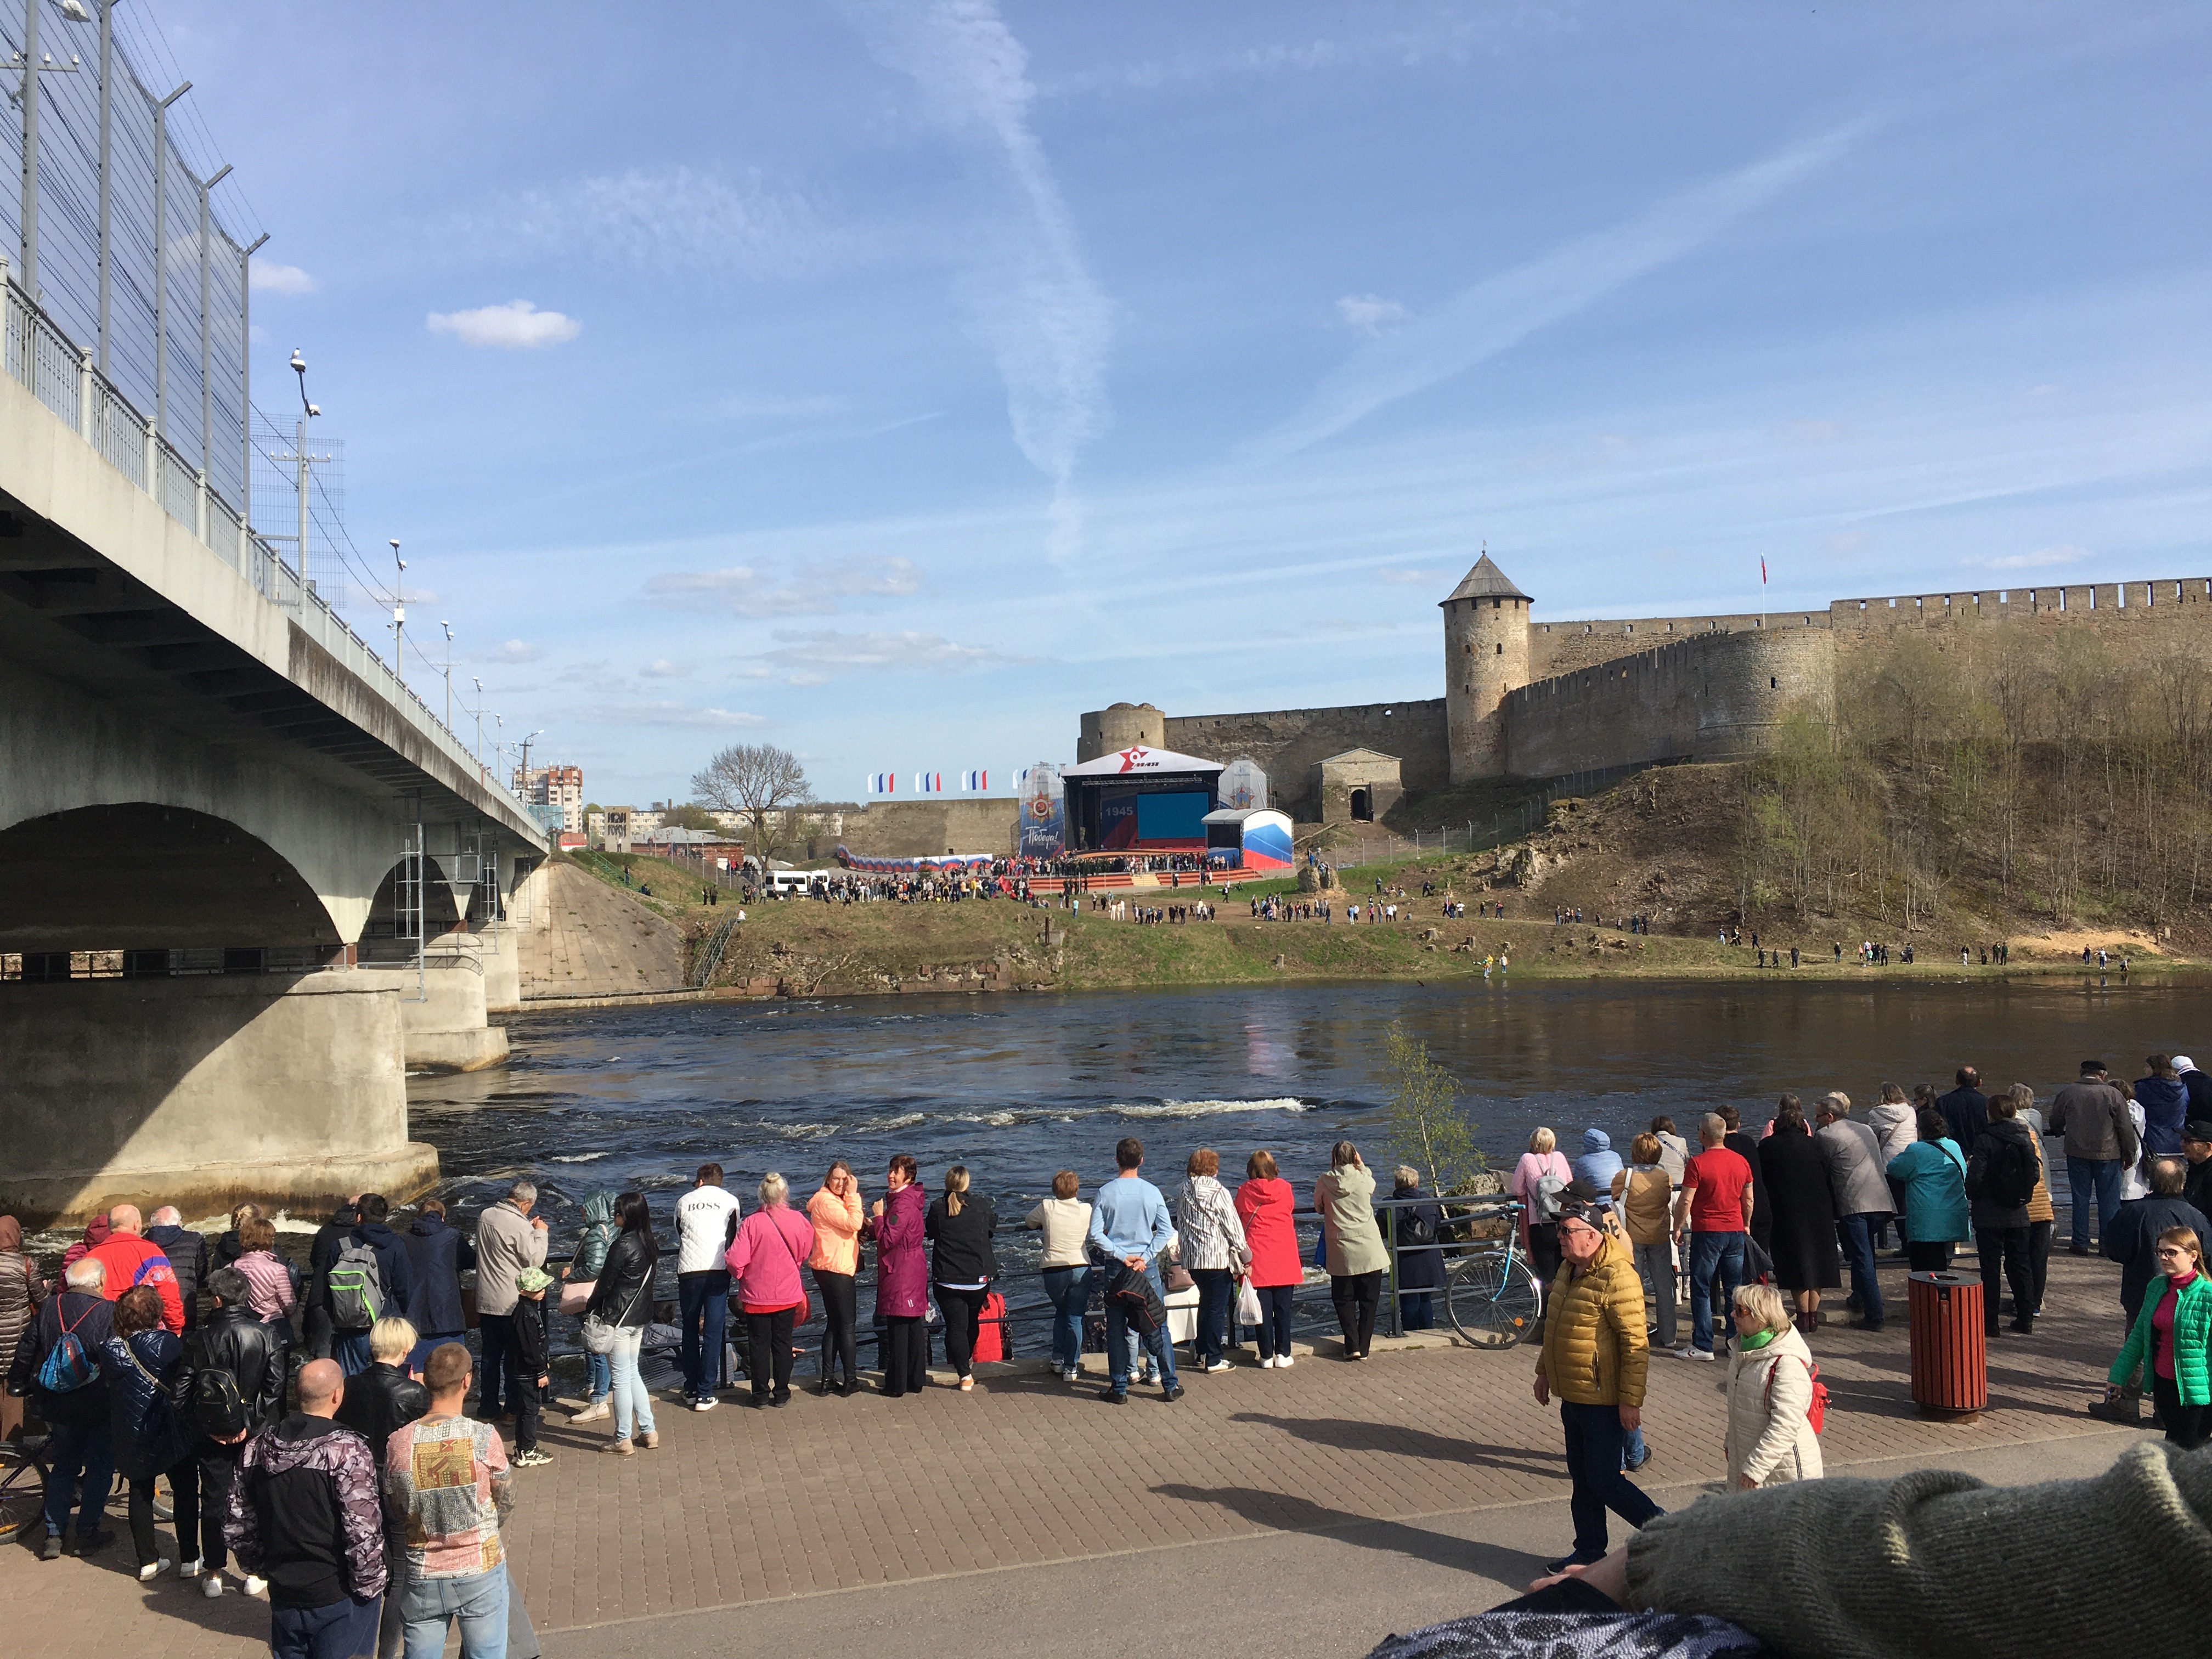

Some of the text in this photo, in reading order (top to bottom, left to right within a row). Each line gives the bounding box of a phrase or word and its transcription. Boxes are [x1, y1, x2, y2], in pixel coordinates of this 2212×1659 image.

[1105, 806, 1133, 816] 1945
[1025, 826, 1059, 850] Победа!
[688, 1202, 720, 1211] BOSS
